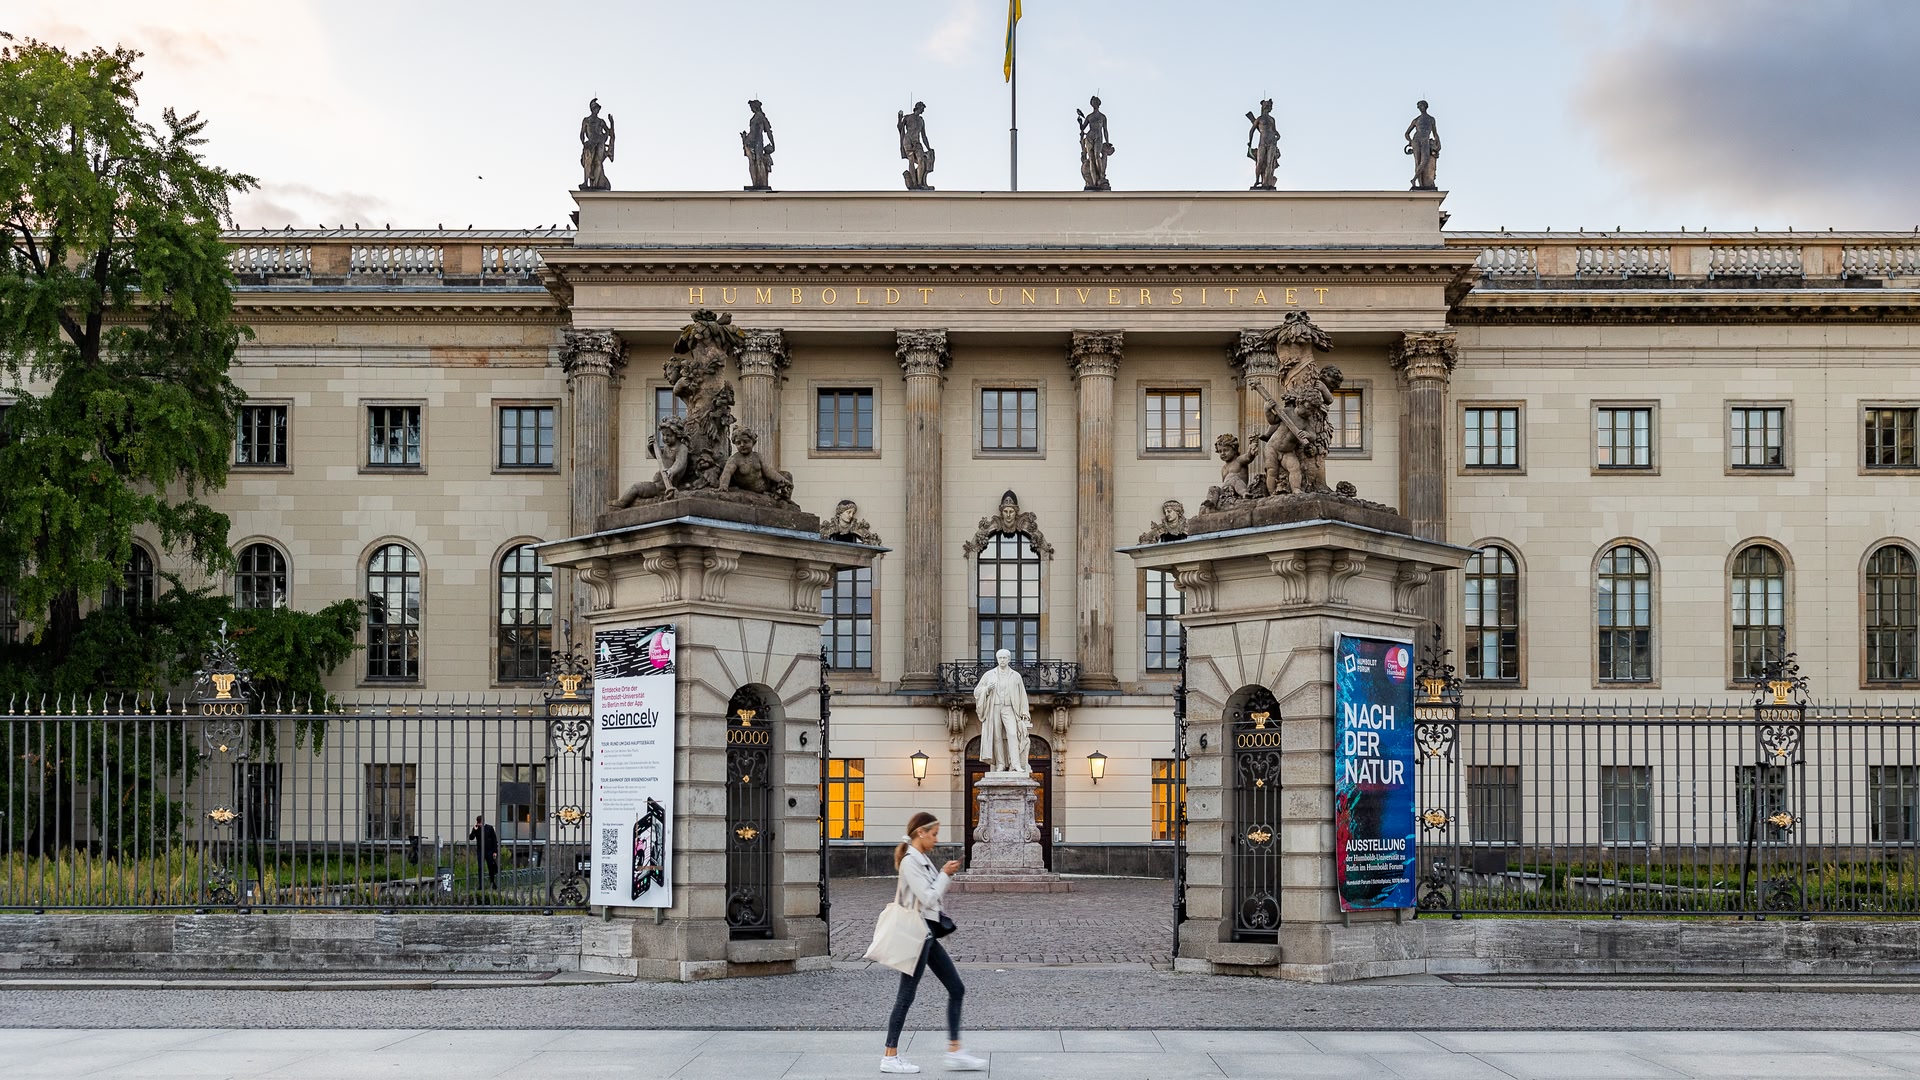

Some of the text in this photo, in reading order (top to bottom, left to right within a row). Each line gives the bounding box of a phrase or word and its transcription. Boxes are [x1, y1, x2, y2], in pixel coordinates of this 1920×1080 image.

[688, 287, 1330, 305] HUMBOLDT UNIVERSITAET
[602, 692, 645, 701] Humboldt-Universität
[602, 708, 659, 728] sciencely
[1344, 702, 1394, 730] NACH
[799, 731, 808, 746] 6
[1200, 733, 1208, 748] 6
[1344, 730, 1380, 757] DER
[1345, 758, 1404, 785] NATUR
[1346, 838, 1406, 852] AUSSTELLUNG
[1353, 853, 1399, 861] Humboldt-Universität
